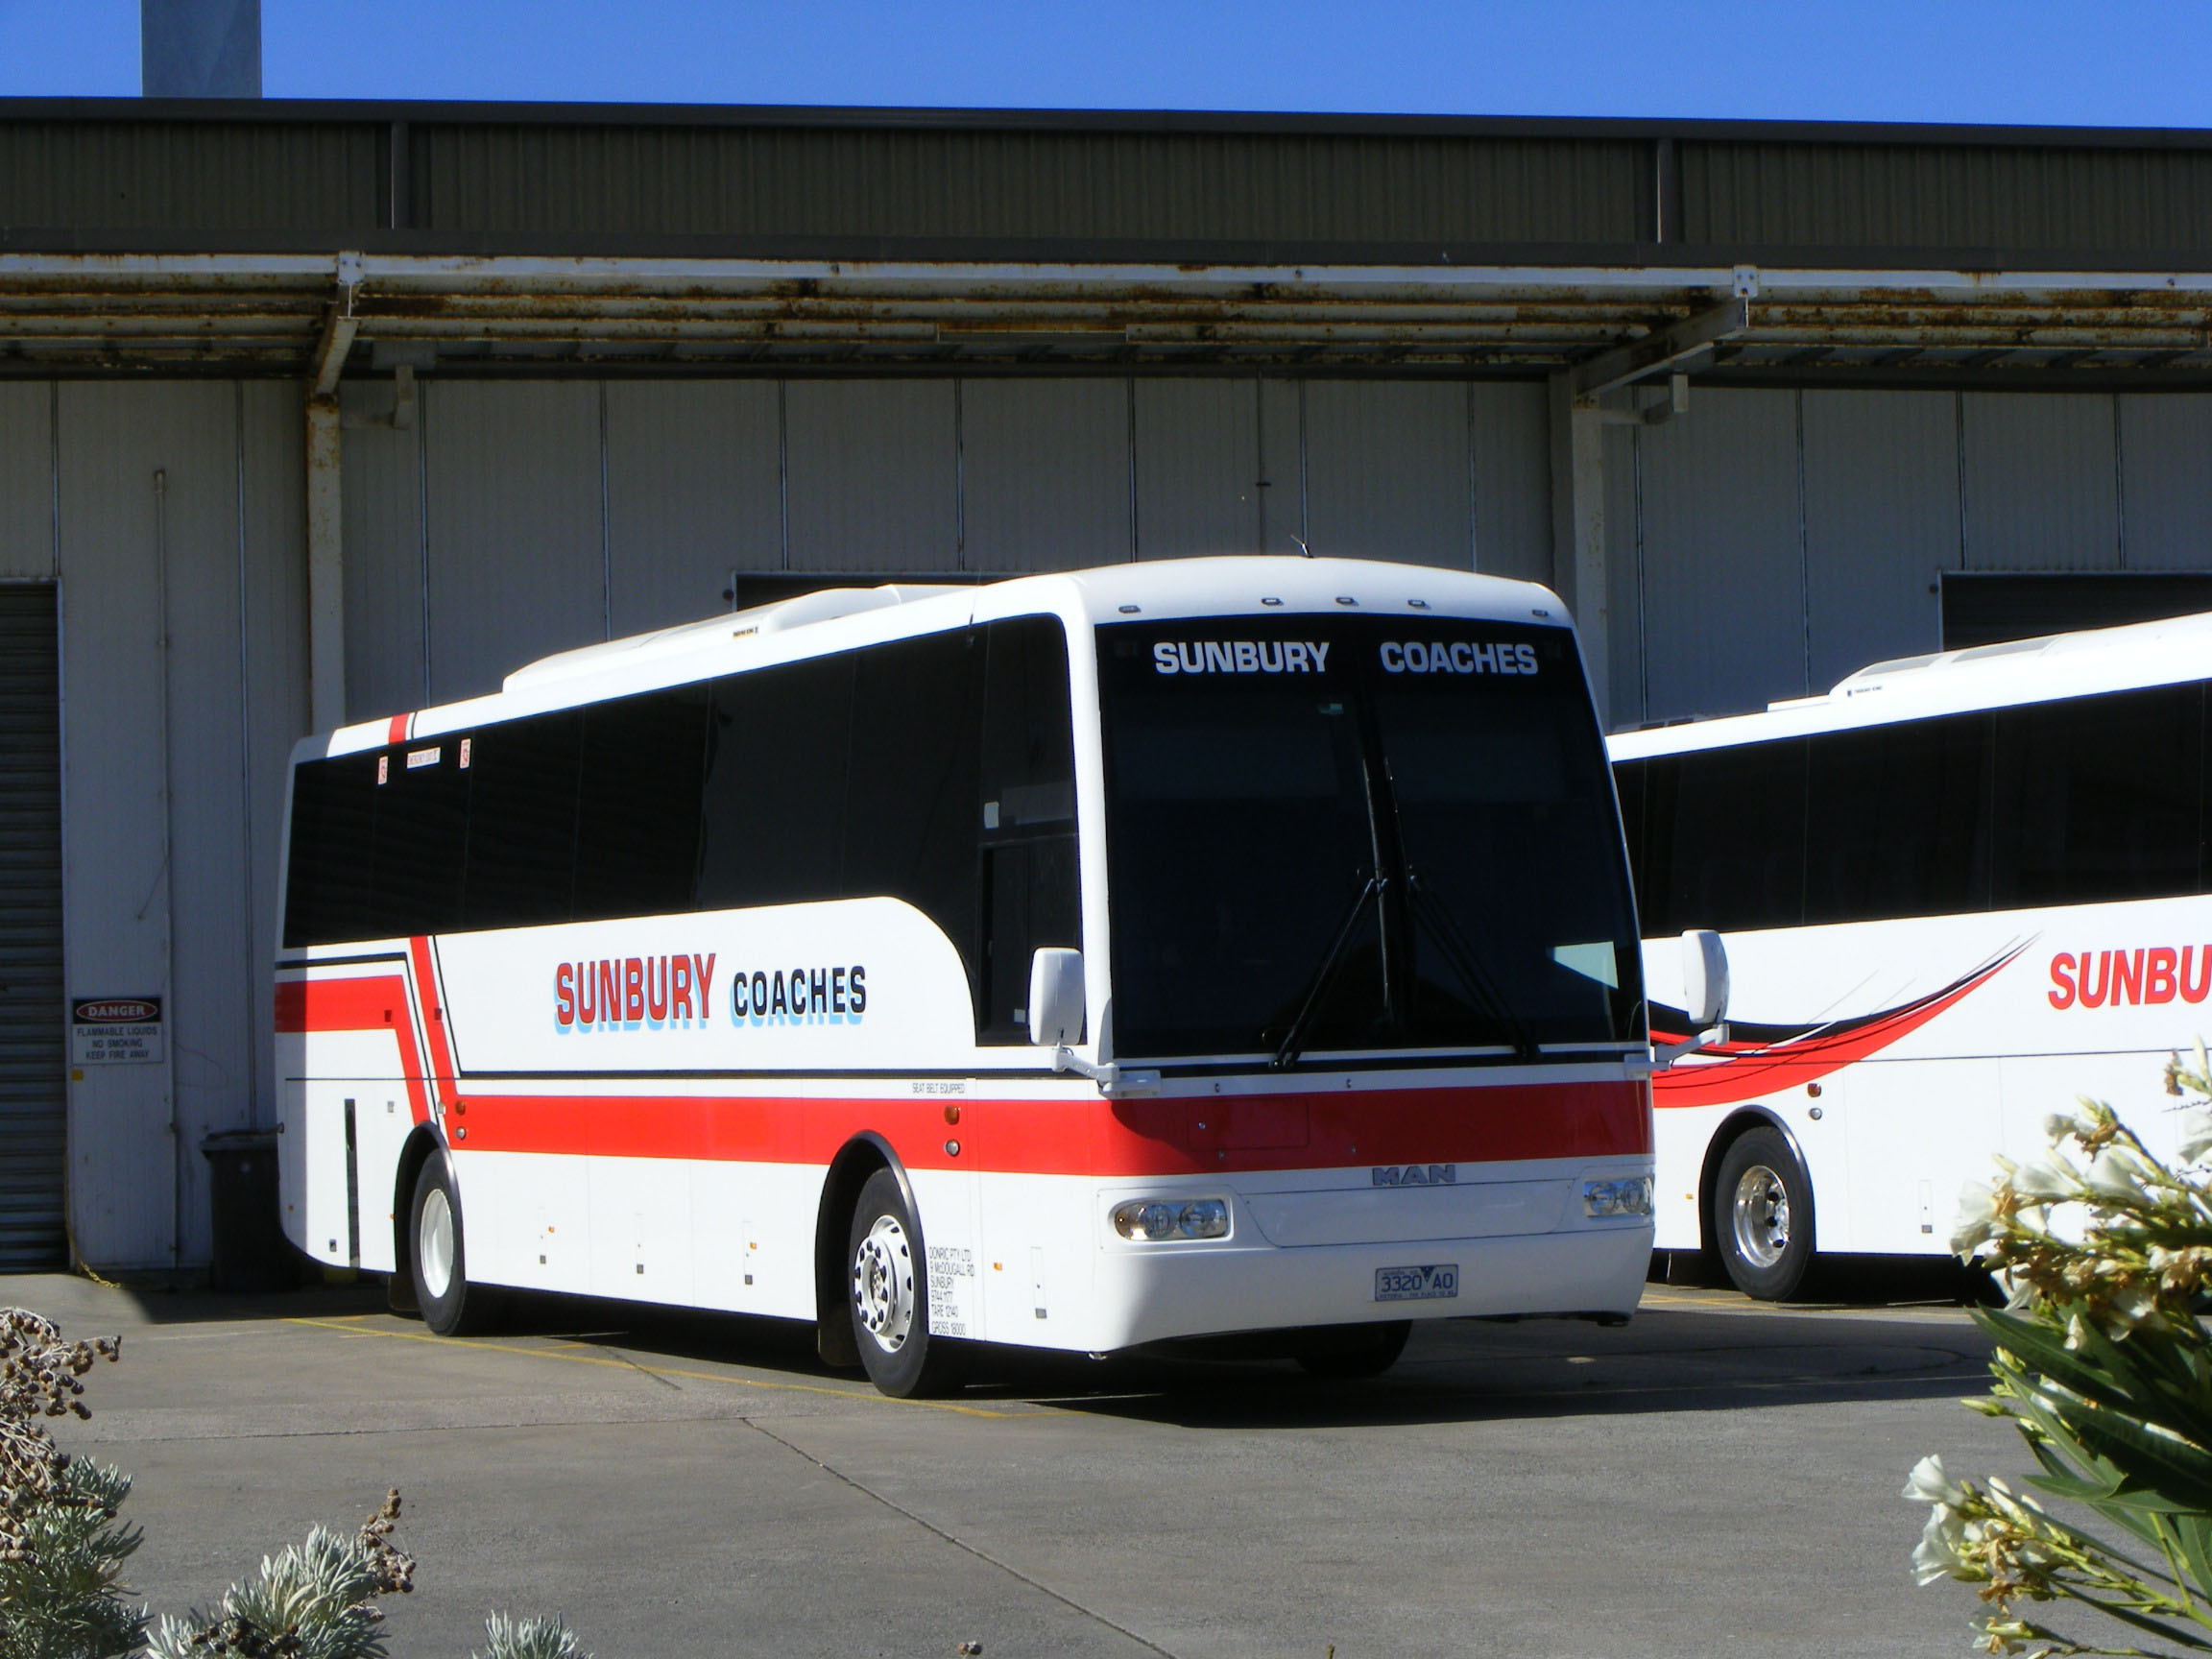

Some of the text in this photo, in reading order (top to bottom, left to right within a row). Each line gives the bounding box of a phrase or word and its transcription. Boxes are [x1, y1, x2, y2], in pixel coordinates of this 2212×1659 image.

[1153, 641, 1538, 675] SUNBURY COACHES
[2048, 944, 2212, 1010] SUNBU
[555, 952, 866, 1027] SUNBURY COACHES
[87, 1005, 146, 1017] DANGER
[77, 1025, 157, 1037] FLAMMABLE LIQUIDS
[91, 1038, 143, 1048] NO SMOKING
[85, 1050, 106, 1060] KEEP
[108, 1049, 126, 1059] FIRE
[1372, 1165, 1456, 1186] MAN
[950, 1247, 960, 1261] PTY
[961, 1249, 972, 1262] LTD
[967, 1263, 975, 1277] RD
[929, 1274, 954, 1289] SUNBURY
[1381, 1272, 1454, 1292] 3320 AO
[931, 1303, 944, 1318] TARE
[931, 1320, 950, 1334] GROSS
